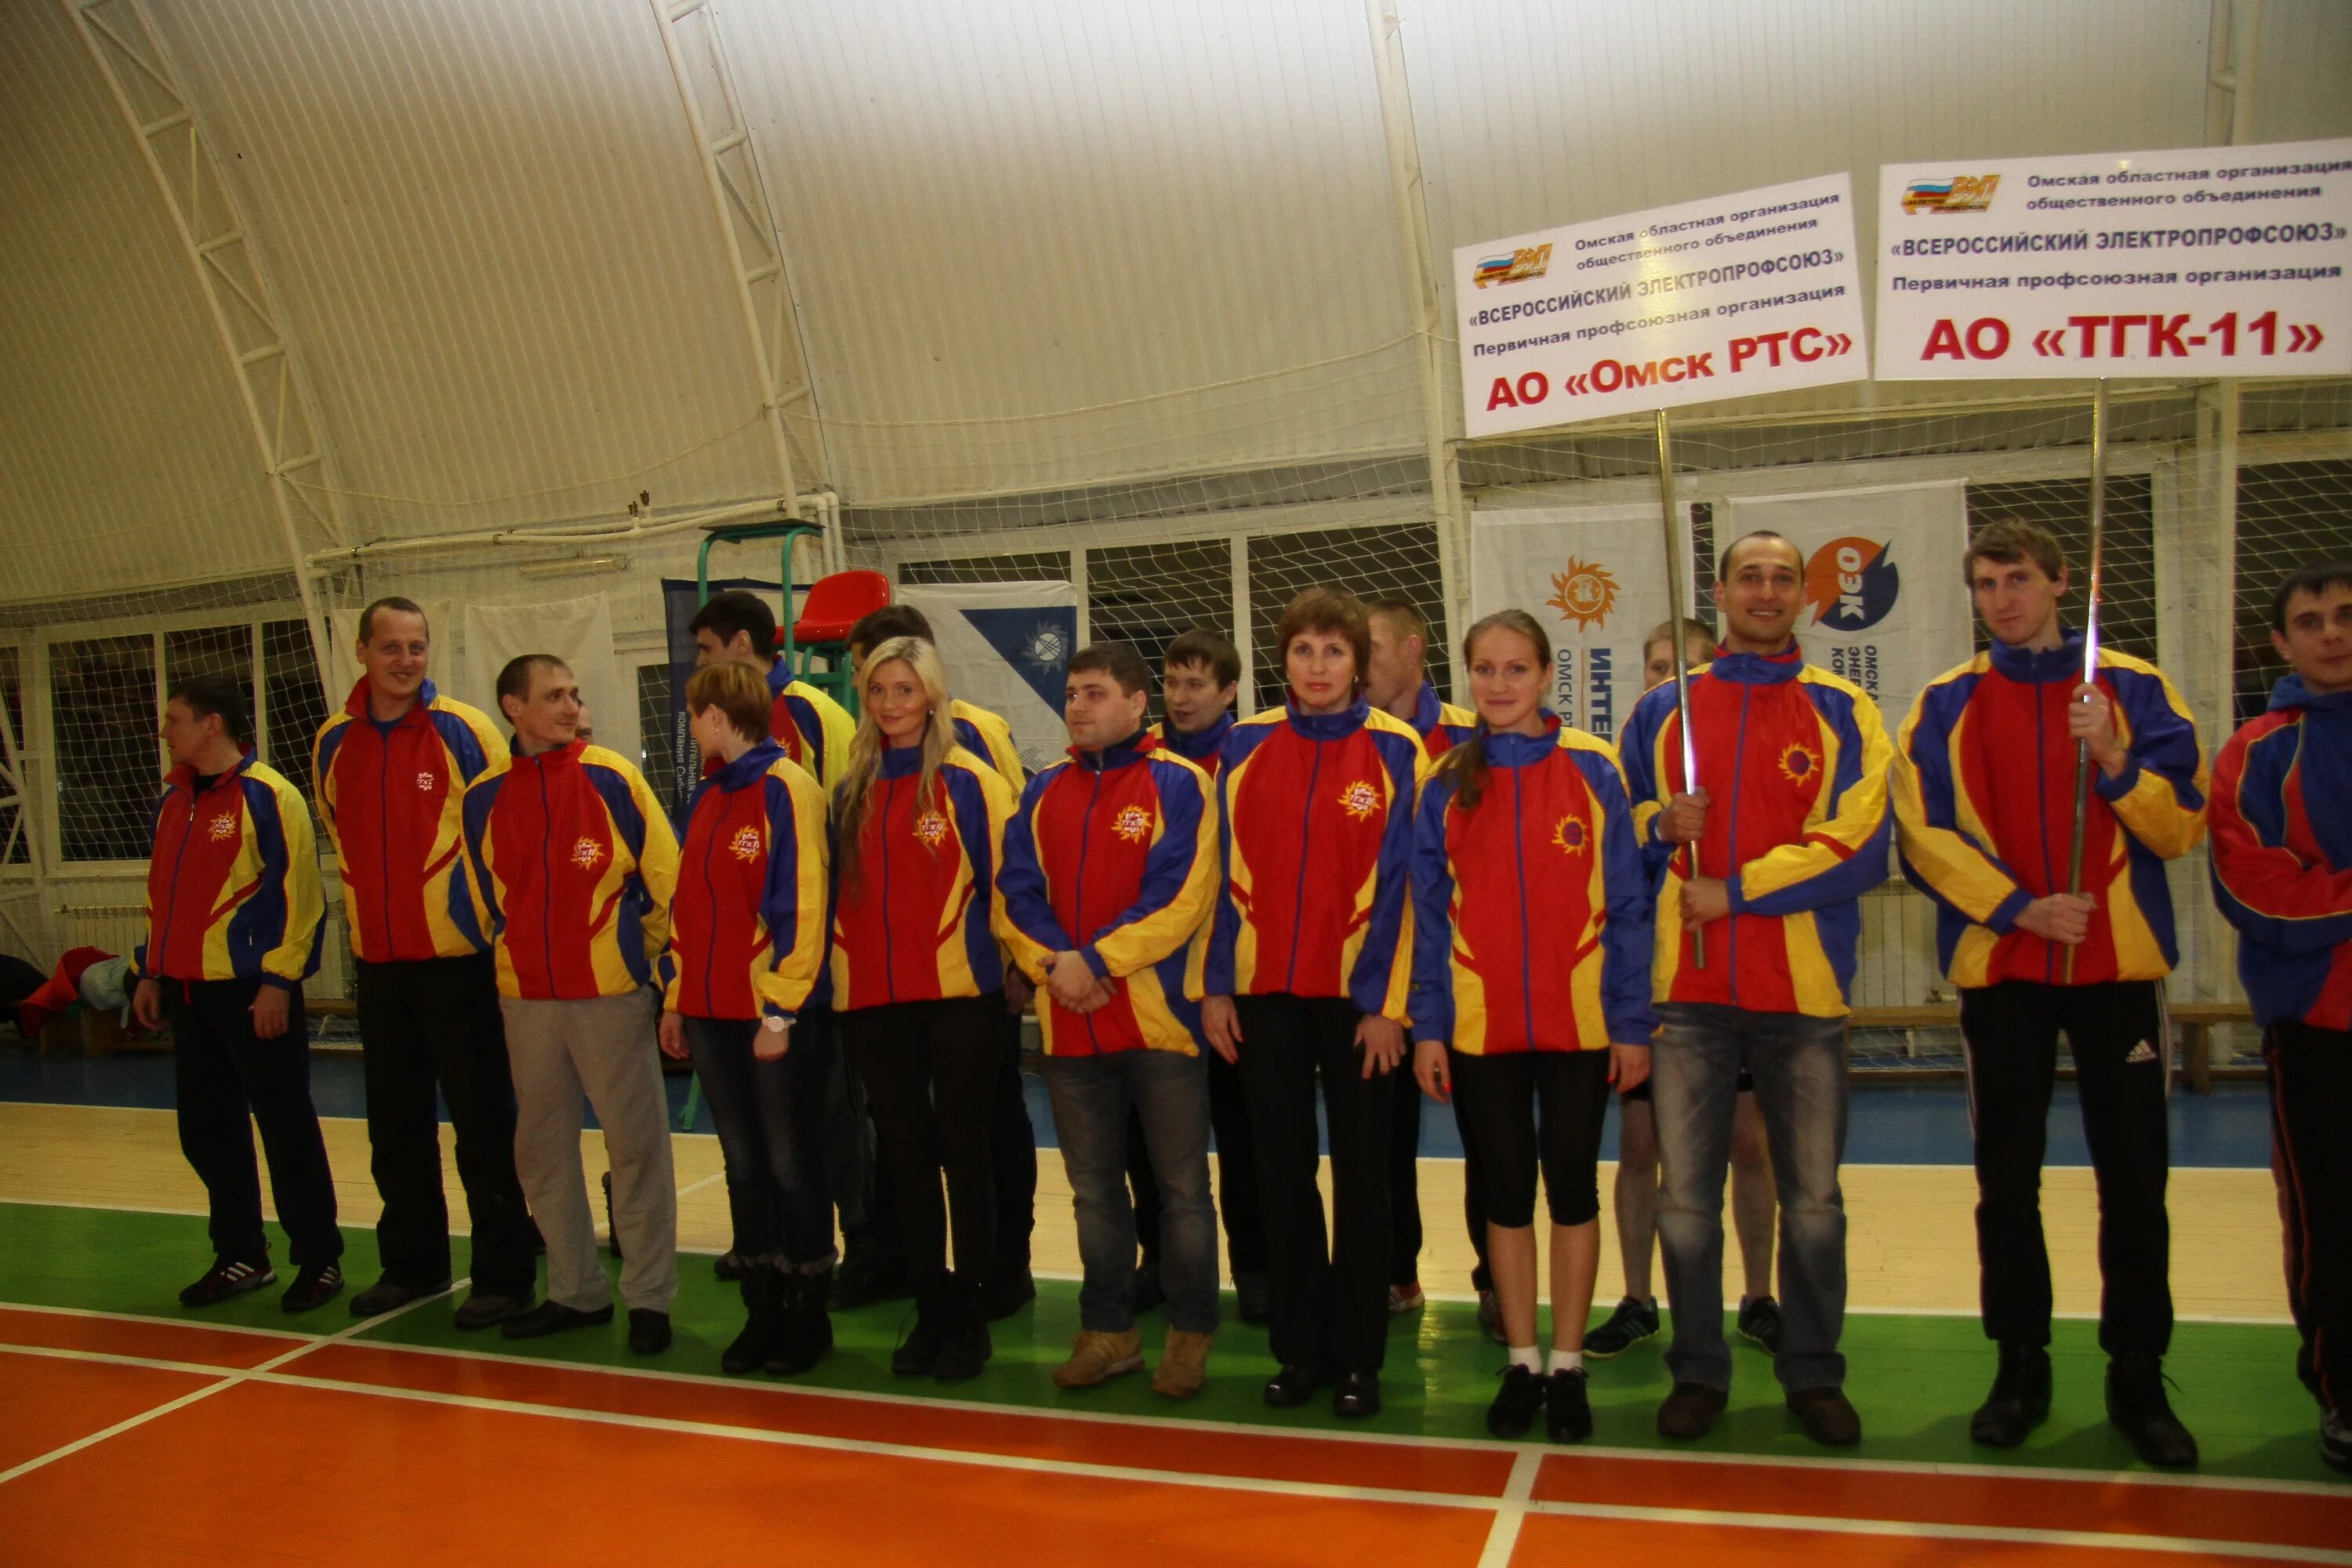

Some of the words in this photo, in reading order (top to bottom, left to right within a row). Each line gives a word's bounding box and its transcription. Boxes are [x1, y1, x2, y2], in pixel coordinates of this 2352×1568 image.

[2027, 174, 2100, 188] Омская
[2107, 169, 2209, 184] областная
[2216, 160, 2352, 181] организация
[2027, 194, 2176, 210] общественного
[2183, 186, 2321, 204] объединения
[1575, 230, 1635, 251] Омская
[1638, 214, 1725, 239] областная
[1730, 194, 1839, 223] организация
[1577, 240, 1700, 270] общественного
[1705, 218, 1818, 247] объединения
[1891, 230, 2088, 256] «ВСЕРОССИЙСКИЙ
[2095, 223, 2347, 249] ЭЛЕКТРОПРОФСОЮЗ»
[1469, 281, 1632, 327] «ВСЕРОССИЙСКИЙ
[1637, 248, 1844, 296] ЭЛЕКТРОПРОФСОЮЗ»
[1893, 276, 2009, 292] Первичная
[2017, 271, 2177, 290] профсоюзная
[2185, 266, 2342, 286] организация
[1473, 331, 1570, 358] Первичная
[1577, 308, 1711, 340] профсоюзная
[1717, 285, 1845, 317] организация
[1920, 317, 2010, 361] АО
[2032, 310, 2325, 359] «ТГК-11»
[1486, 371, 1549, 412] АО
[1564, 352, 1715, 396] «Омск
[1729, 327, 1852, 373] РТС»
[1836, 546, 1865, 621] ОЭК
[1557, 648, 1572, 705] ОМСК
[1848, 646, 1861, 687] ЭНЕР
[1591, 648, 1612, 746] ИНТЕ
[676, 711, 686, 763] компания
